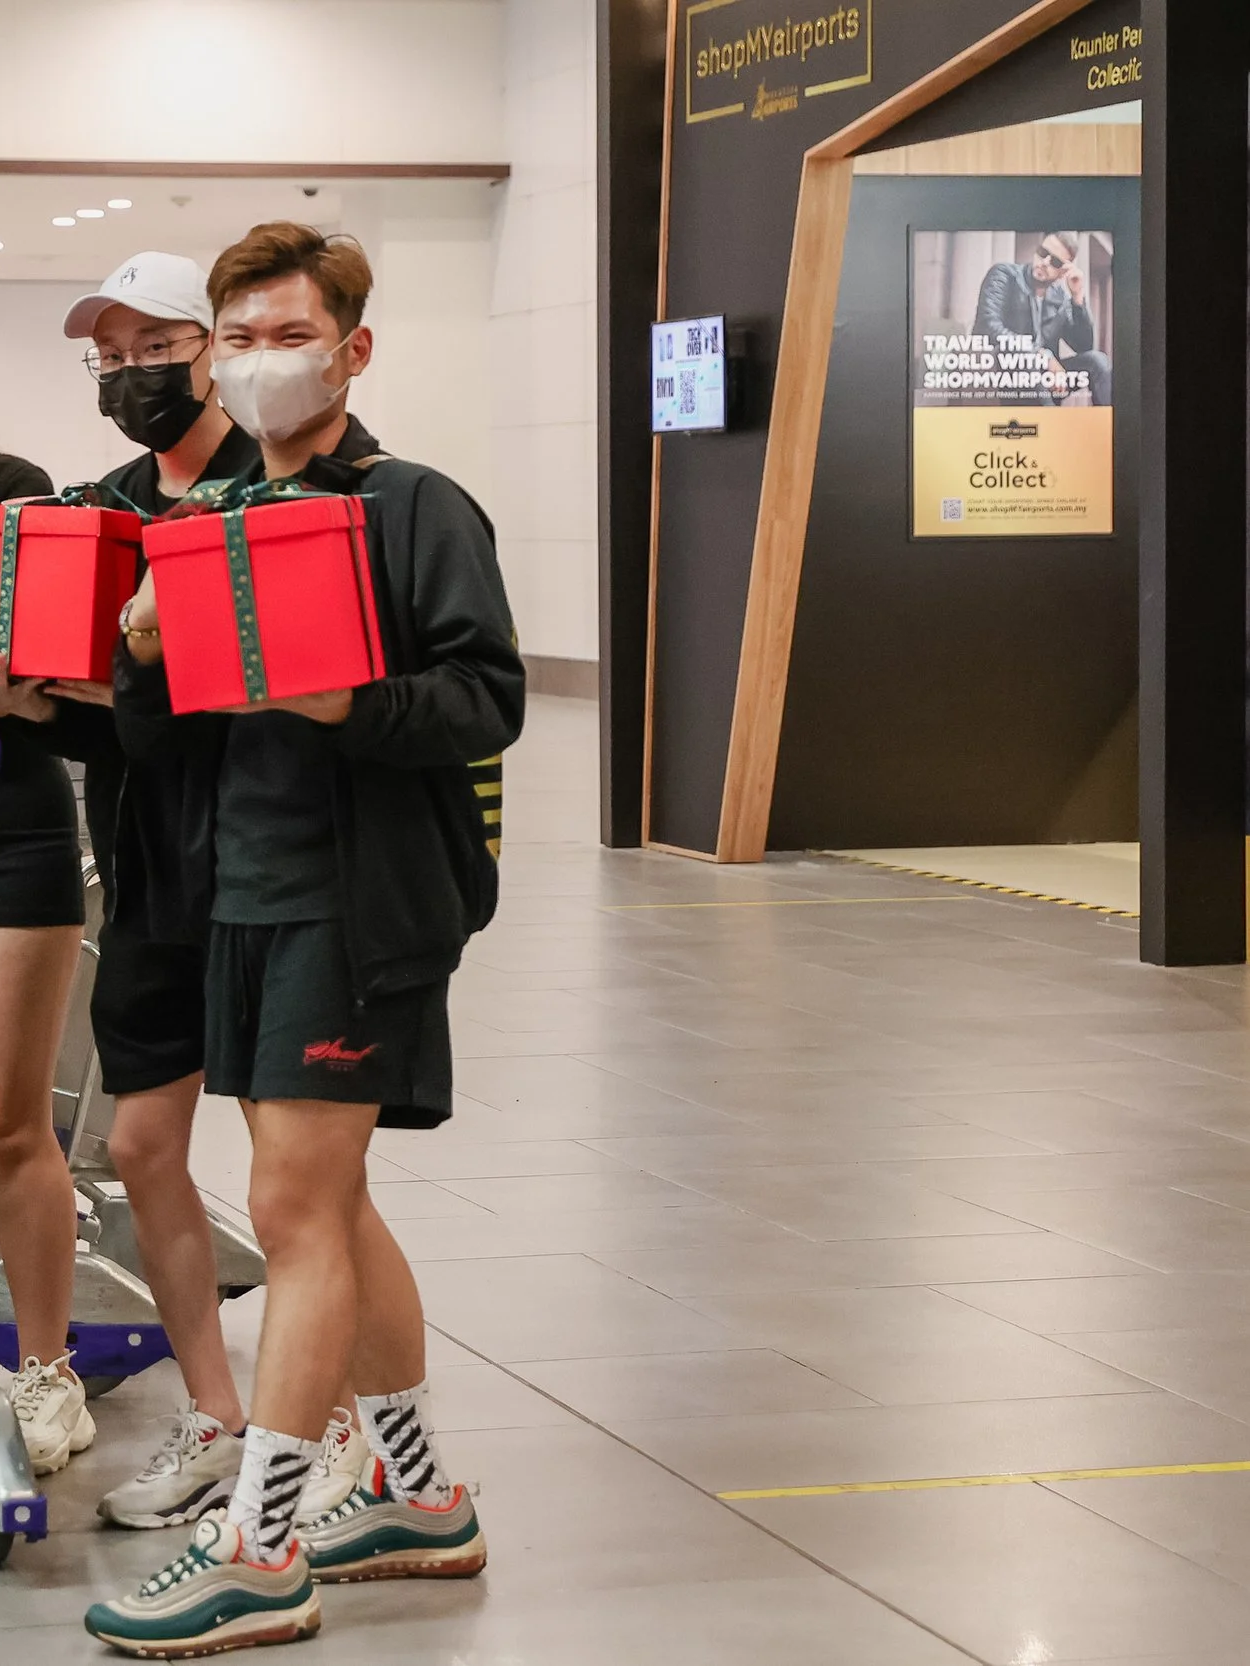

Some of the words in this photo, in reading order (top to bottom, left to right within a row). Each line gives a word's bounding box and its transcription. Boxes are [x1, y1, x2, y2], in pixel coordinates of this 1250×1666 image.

[696, 5, 860, 79] shopMYairports
[1071, 30, 1120, 60] Kaunter
[923, 335, 994, 351] TRAVEL
[996, 335, 1033, 351] THE
[923, 353, 994, 370] WORLD
[997, 353, 1050, 370] WITH
[923, 371, 1090, 389] SHOPMYAIRPORTS
[974, 451, 1028, 469] Click
[1031, 460, 1038, 468] &
[969, 471, 1047, 489] Collect
